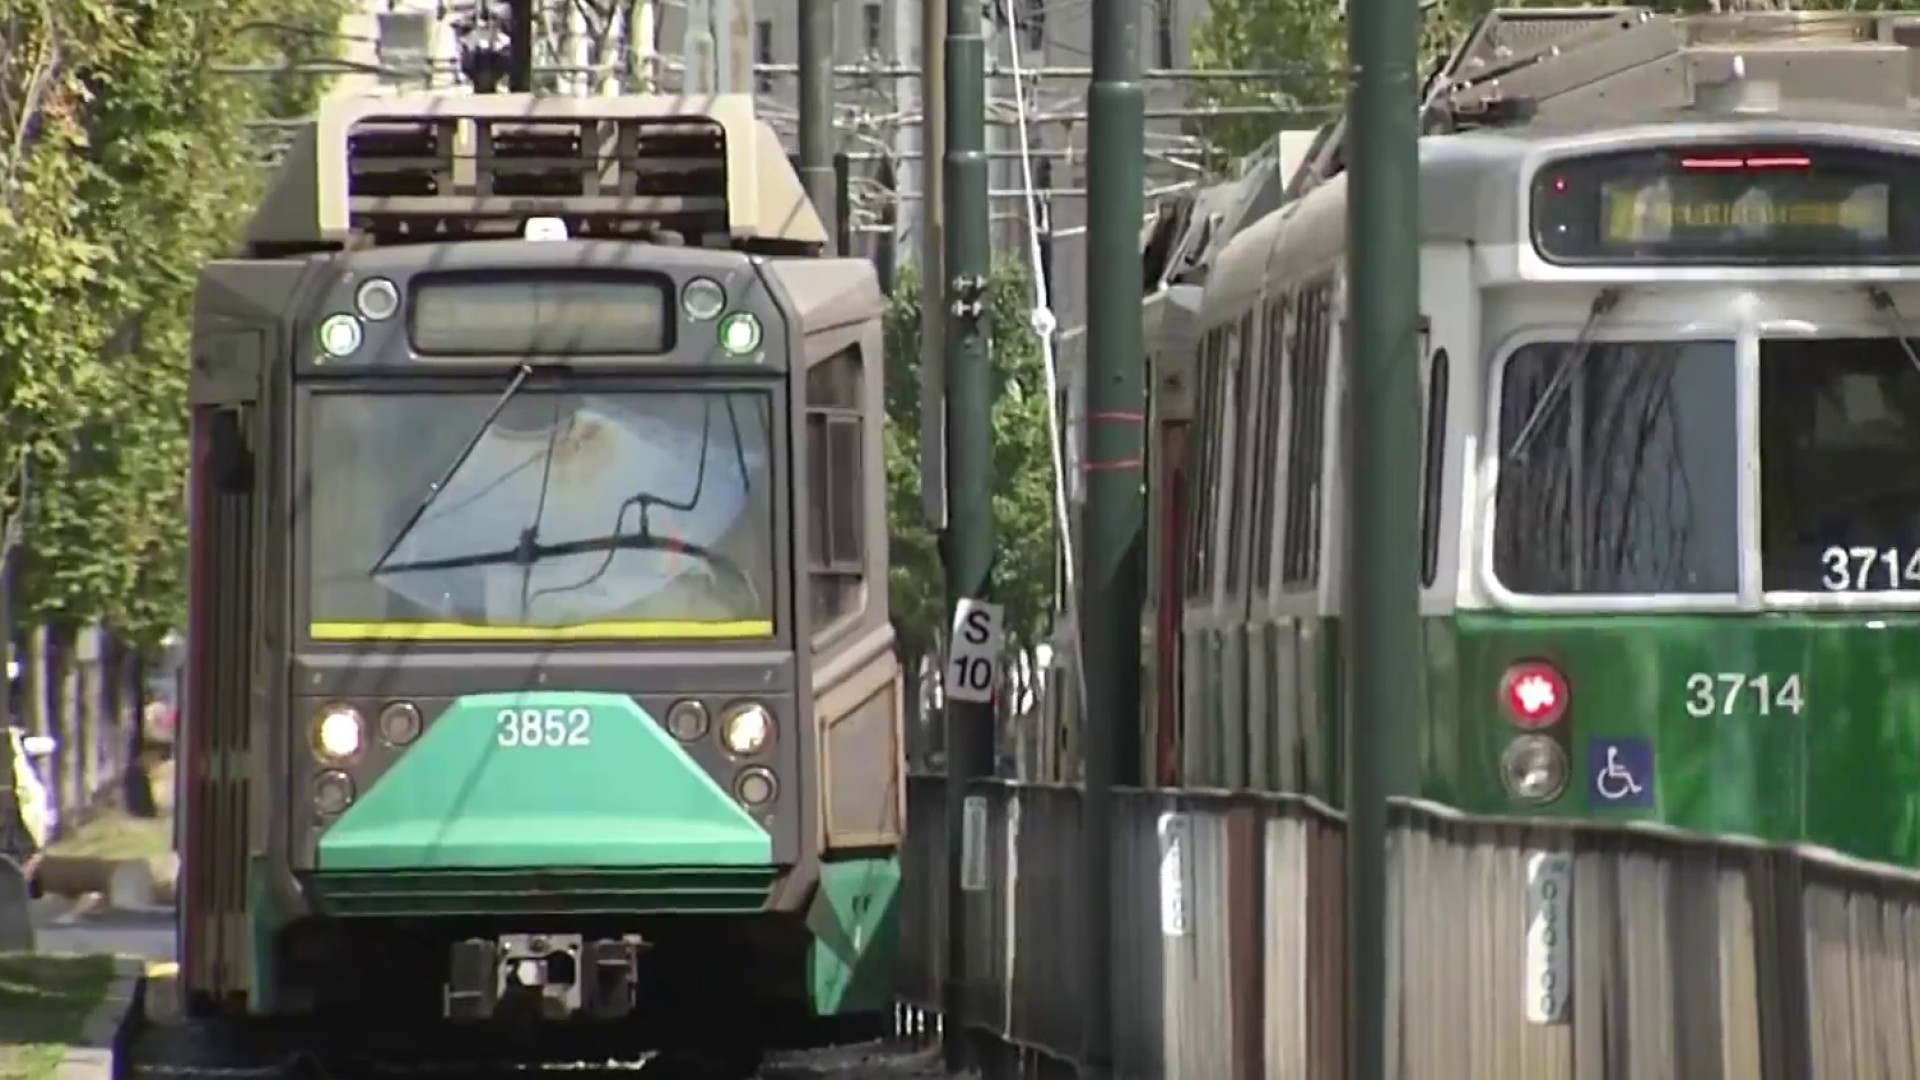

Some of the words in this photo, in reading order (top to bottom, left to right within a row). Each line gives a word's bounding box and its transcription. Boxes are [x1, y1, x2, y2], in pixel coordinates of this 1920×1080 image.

[965, 610, 990, 644] S
[953, 655, 991, 690] 10
[1686, 672, 1805, 717] 3714
[497, 708, 590, 746] 3852
